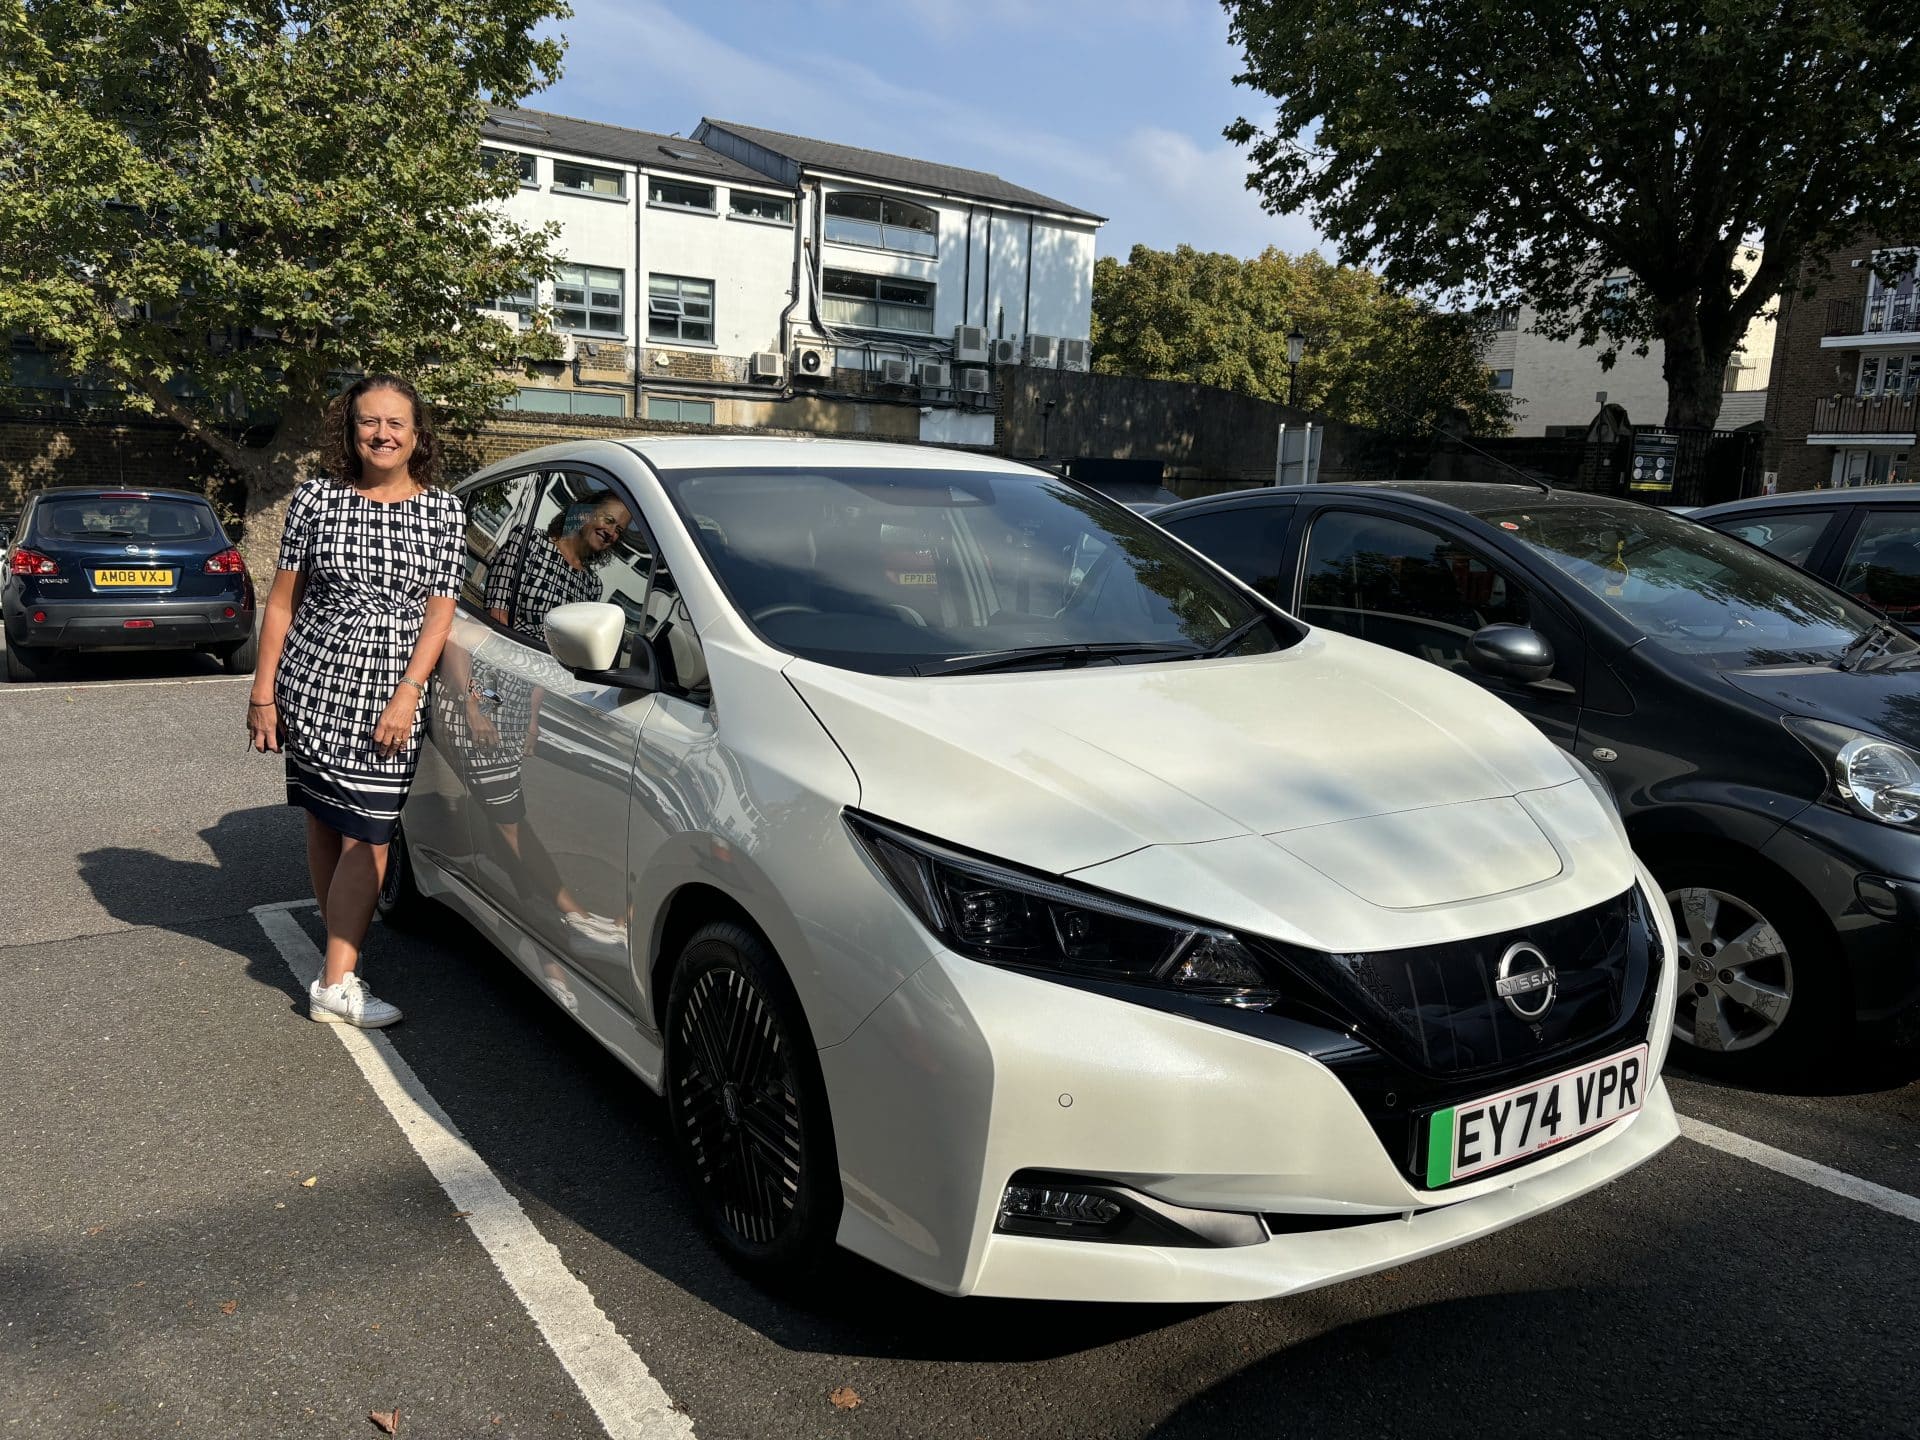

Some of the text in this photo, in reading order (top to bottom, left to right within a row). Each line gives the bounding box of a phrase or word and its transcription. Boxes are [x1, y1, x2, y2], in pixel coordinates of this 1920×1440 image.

[101, 571, 166, 582] AM08 VXJ
[1499, 968, 1557, 995] NISSAN
[1457, 1057, 1639, 1169] EY74 VPR
